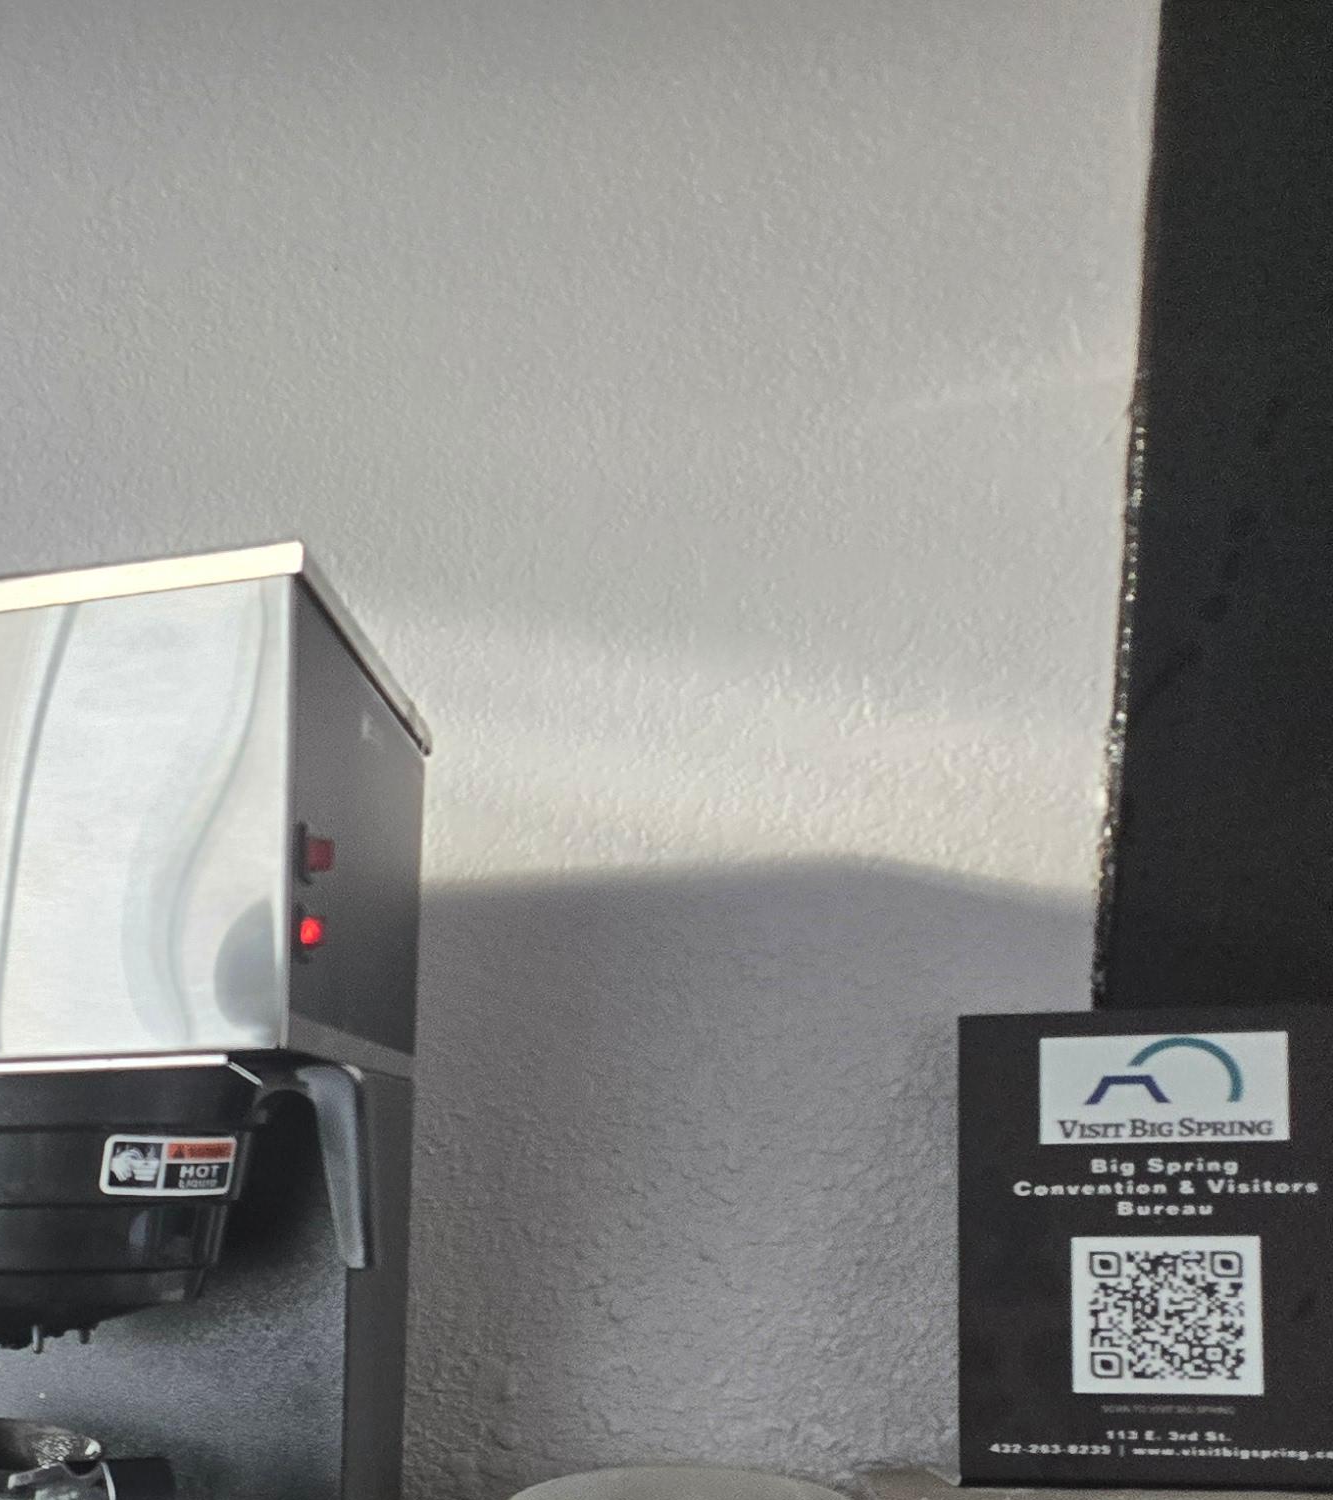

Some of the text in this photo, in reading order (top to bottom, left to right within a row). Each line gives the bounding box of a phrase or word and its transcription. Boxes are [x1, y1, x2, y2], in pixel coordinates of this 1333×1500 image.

[1058, 1118, 1273, 1139] VISIT BIG SPRING
[180, 1165, 219, 1178] HOT
[1091, 1157, 1238, 1176] Big Spring
[1013, 1178, 1318, 1196] Convention & Visitors
[1117, 1201, 1213, 1216] Bureau
[1168, 1430, 1198, 1441] 3rd
